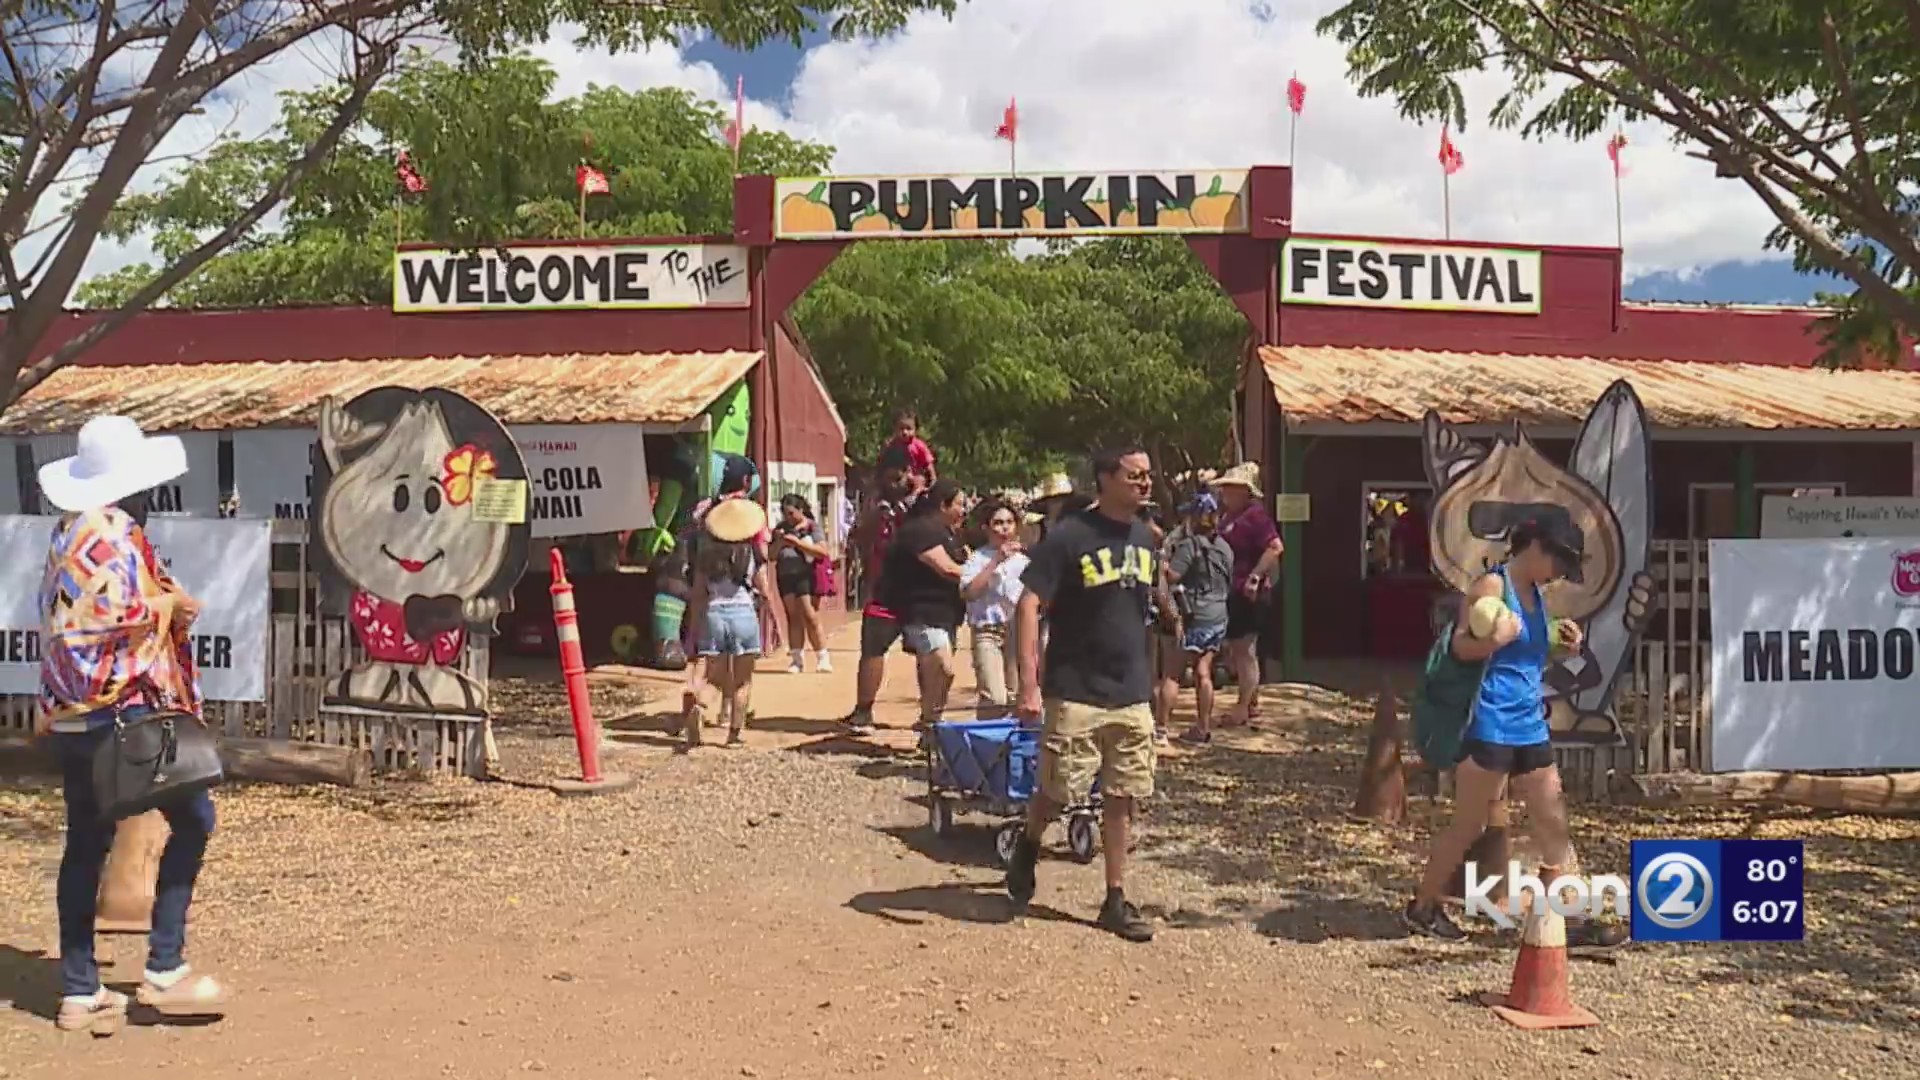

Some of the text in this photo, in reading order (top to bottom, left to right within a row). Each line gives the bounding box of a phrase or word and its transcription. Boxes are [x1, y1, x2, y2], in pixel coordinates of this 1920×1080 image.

[828, 174, 1196, 237] PUMPKIN
[401, 249, 745, 304] WELCOME TO THE
[1292, 247, 1534, 304] FESTIVAL
[532, 465, 602, 491] -COLA
[1787, 505, 1842, 524] Supporting
[0, 630, 41, 662] ED
[191, 634, 232, 668] ER
[1743, 628, 1920, 682] MEADO
